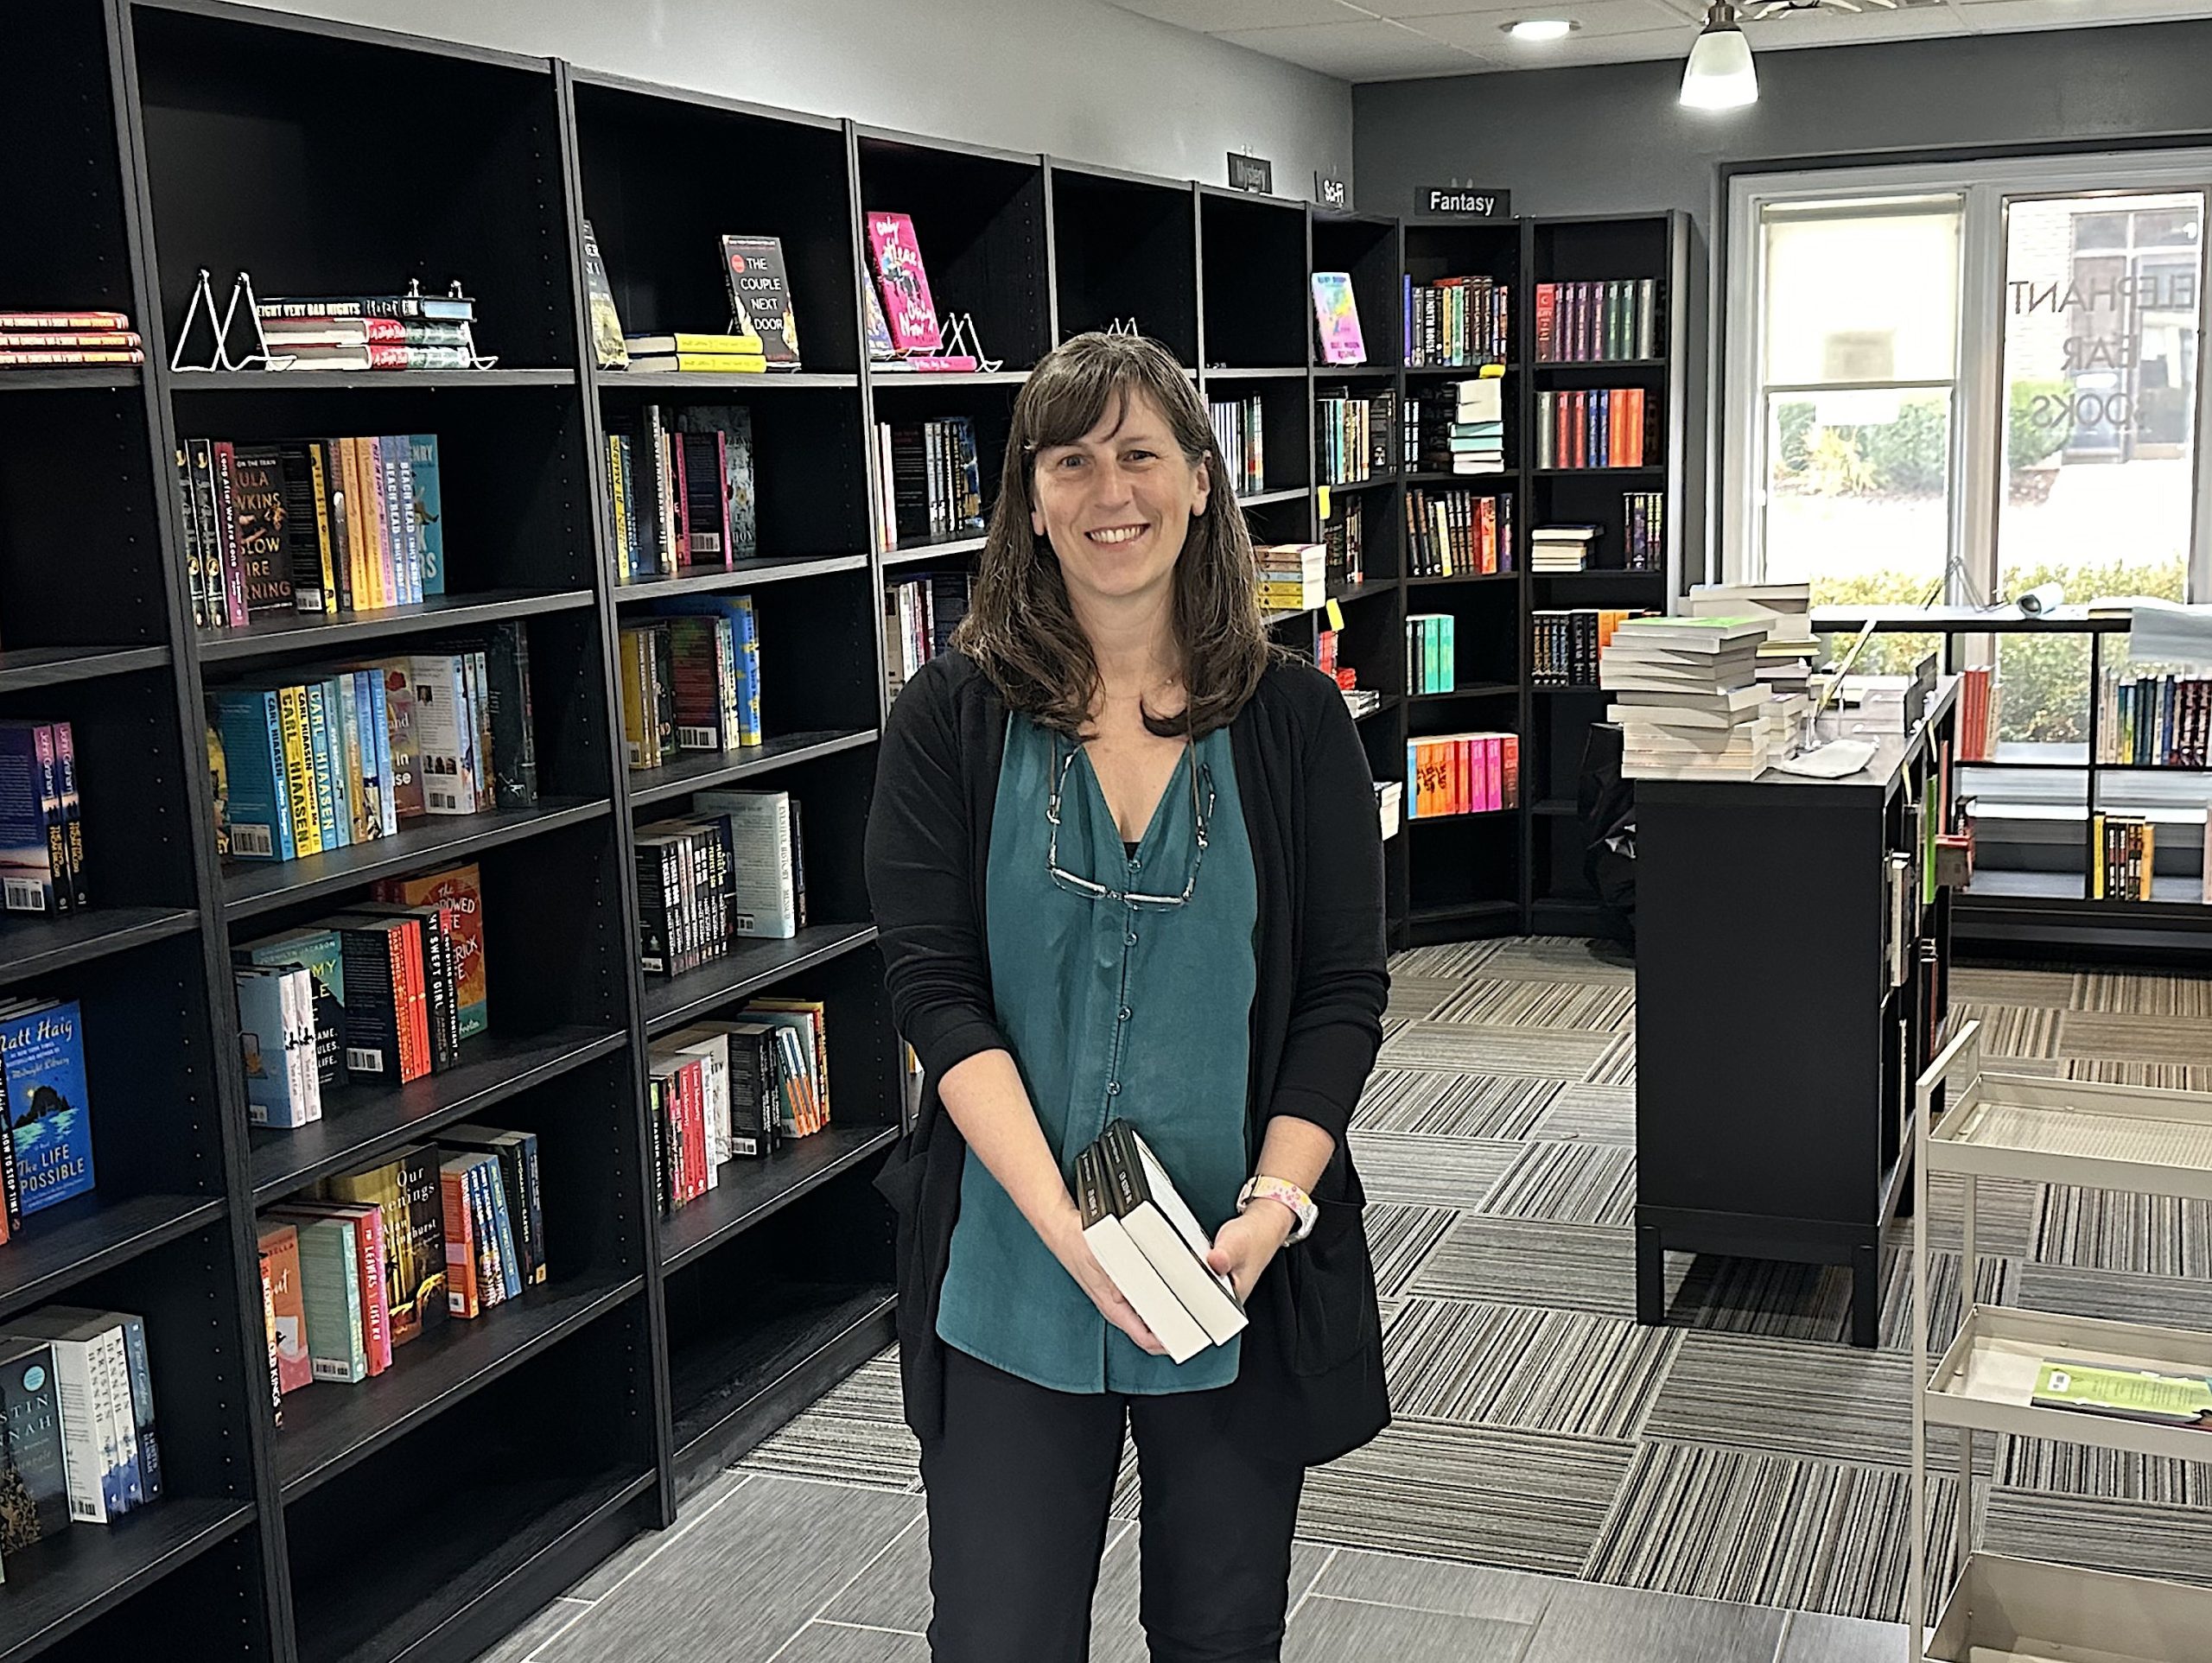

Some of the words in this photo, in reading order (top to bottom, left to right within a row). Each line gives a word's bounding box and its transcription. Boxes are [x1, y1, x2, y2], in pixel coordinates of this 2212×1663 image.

[1430, 192, 1495, 216] Fantasy
[747, 258, 767, 270] THE
[740, 278, 781, 291] COUPLE
[257, 305, 282, 317] EIGHT
[283, 303, 306, 316] VERY
[327, 302, 361, 315] NIGHTS
[751, 298, 778, 311] NEXT
[754, 318, 784, 330] DOOR
[1426, 327, 1435, 353] HOUSE
[219, 453, 229, 477] Long
[222, 479, 232, 504] After
[235, 472, 269, 487] ULA
[385, 462, 398, 500] BEACH
[399, 461, 412, 499] BEACH
[225, 506, 233, 521] We
[235, 492, 281, 511] WKINS
[389, 504, 402, 534] READ
[404, 504, 415, 532] READ
[226, 524, 235, 540] Are
[229, 543, 238, 568] Gone
[245, 561, 270, 576] IRE
[266, 697, 277, 725] CARL
[297, 693, 307, 720] CARL
[309, 691, 324, 737] CARL
[39, 732, 51, 756] John
[60, 727, 71, 752] John
[270, 729, 283, 776] HIAASEN
[301, 723, 313, 770] HIAASEN
[42, 758, 54, 798] Grisham
[62, 754, 75, 793] Grisham
[280, 694, 297, 742] CARL
[289, 762, 309, 842] HIAASEN
[276, 780, 286, 806] Native
[315, 752, 334, 830] HIAASEN
[280, 808, 289, 836] Tongue
[778, 807, 787, 845] EVENTFUL
[707, 847, 715, 874] PERFECT
[780, 847, 790, 880] HISTORY
[312, 960, 336, 977] MY
[429, 936, 442, 975] SWEET
[433, 981, 444, 1009] GIRL
[37, 1017, 73, 1042] Haig
[316, 1028, 338, 1041] AME.
[317, 1041, 340, 1055] ULES.
[318, 1055, 337, 1068] LIFE.
[2, 1133, 11, 1152] HOW
[4, 1155, 13, 1166] TO
[42, 1144, 69, 1168] LIFE
[6, 1170, 16, 1190] STOP
[20, 1157, 85, 1196] POSSIBLE
[397, 1168, 423, 1187] Our
[9, 1193, 18, 1213] TIME
[380, 1183, 435, 1214] venings
[516, 1159, 525, 1193] WOMAN
[521, 1209, 531, 1242] GARDEN
[365, 1246, 378, 1287] LEAVERS
[370, 1304, 380, 1324] LISA
[372, 1329, 382, 1340] KO
[268, 1342, 279, 1368] OLD
[96, 1347, 111, 1420] KRISTIN
[106, 1342, 122, 1413] HANNAH
[115, 1337, 130, 1410] KRISTIN
[87, 1352, 104, 1423] HANNAH
[270, 1368, 283, 1407] KINGS
[0, 1393, 48, 1424] STIN
[143, 1433, 154, 1473] HANNAH
